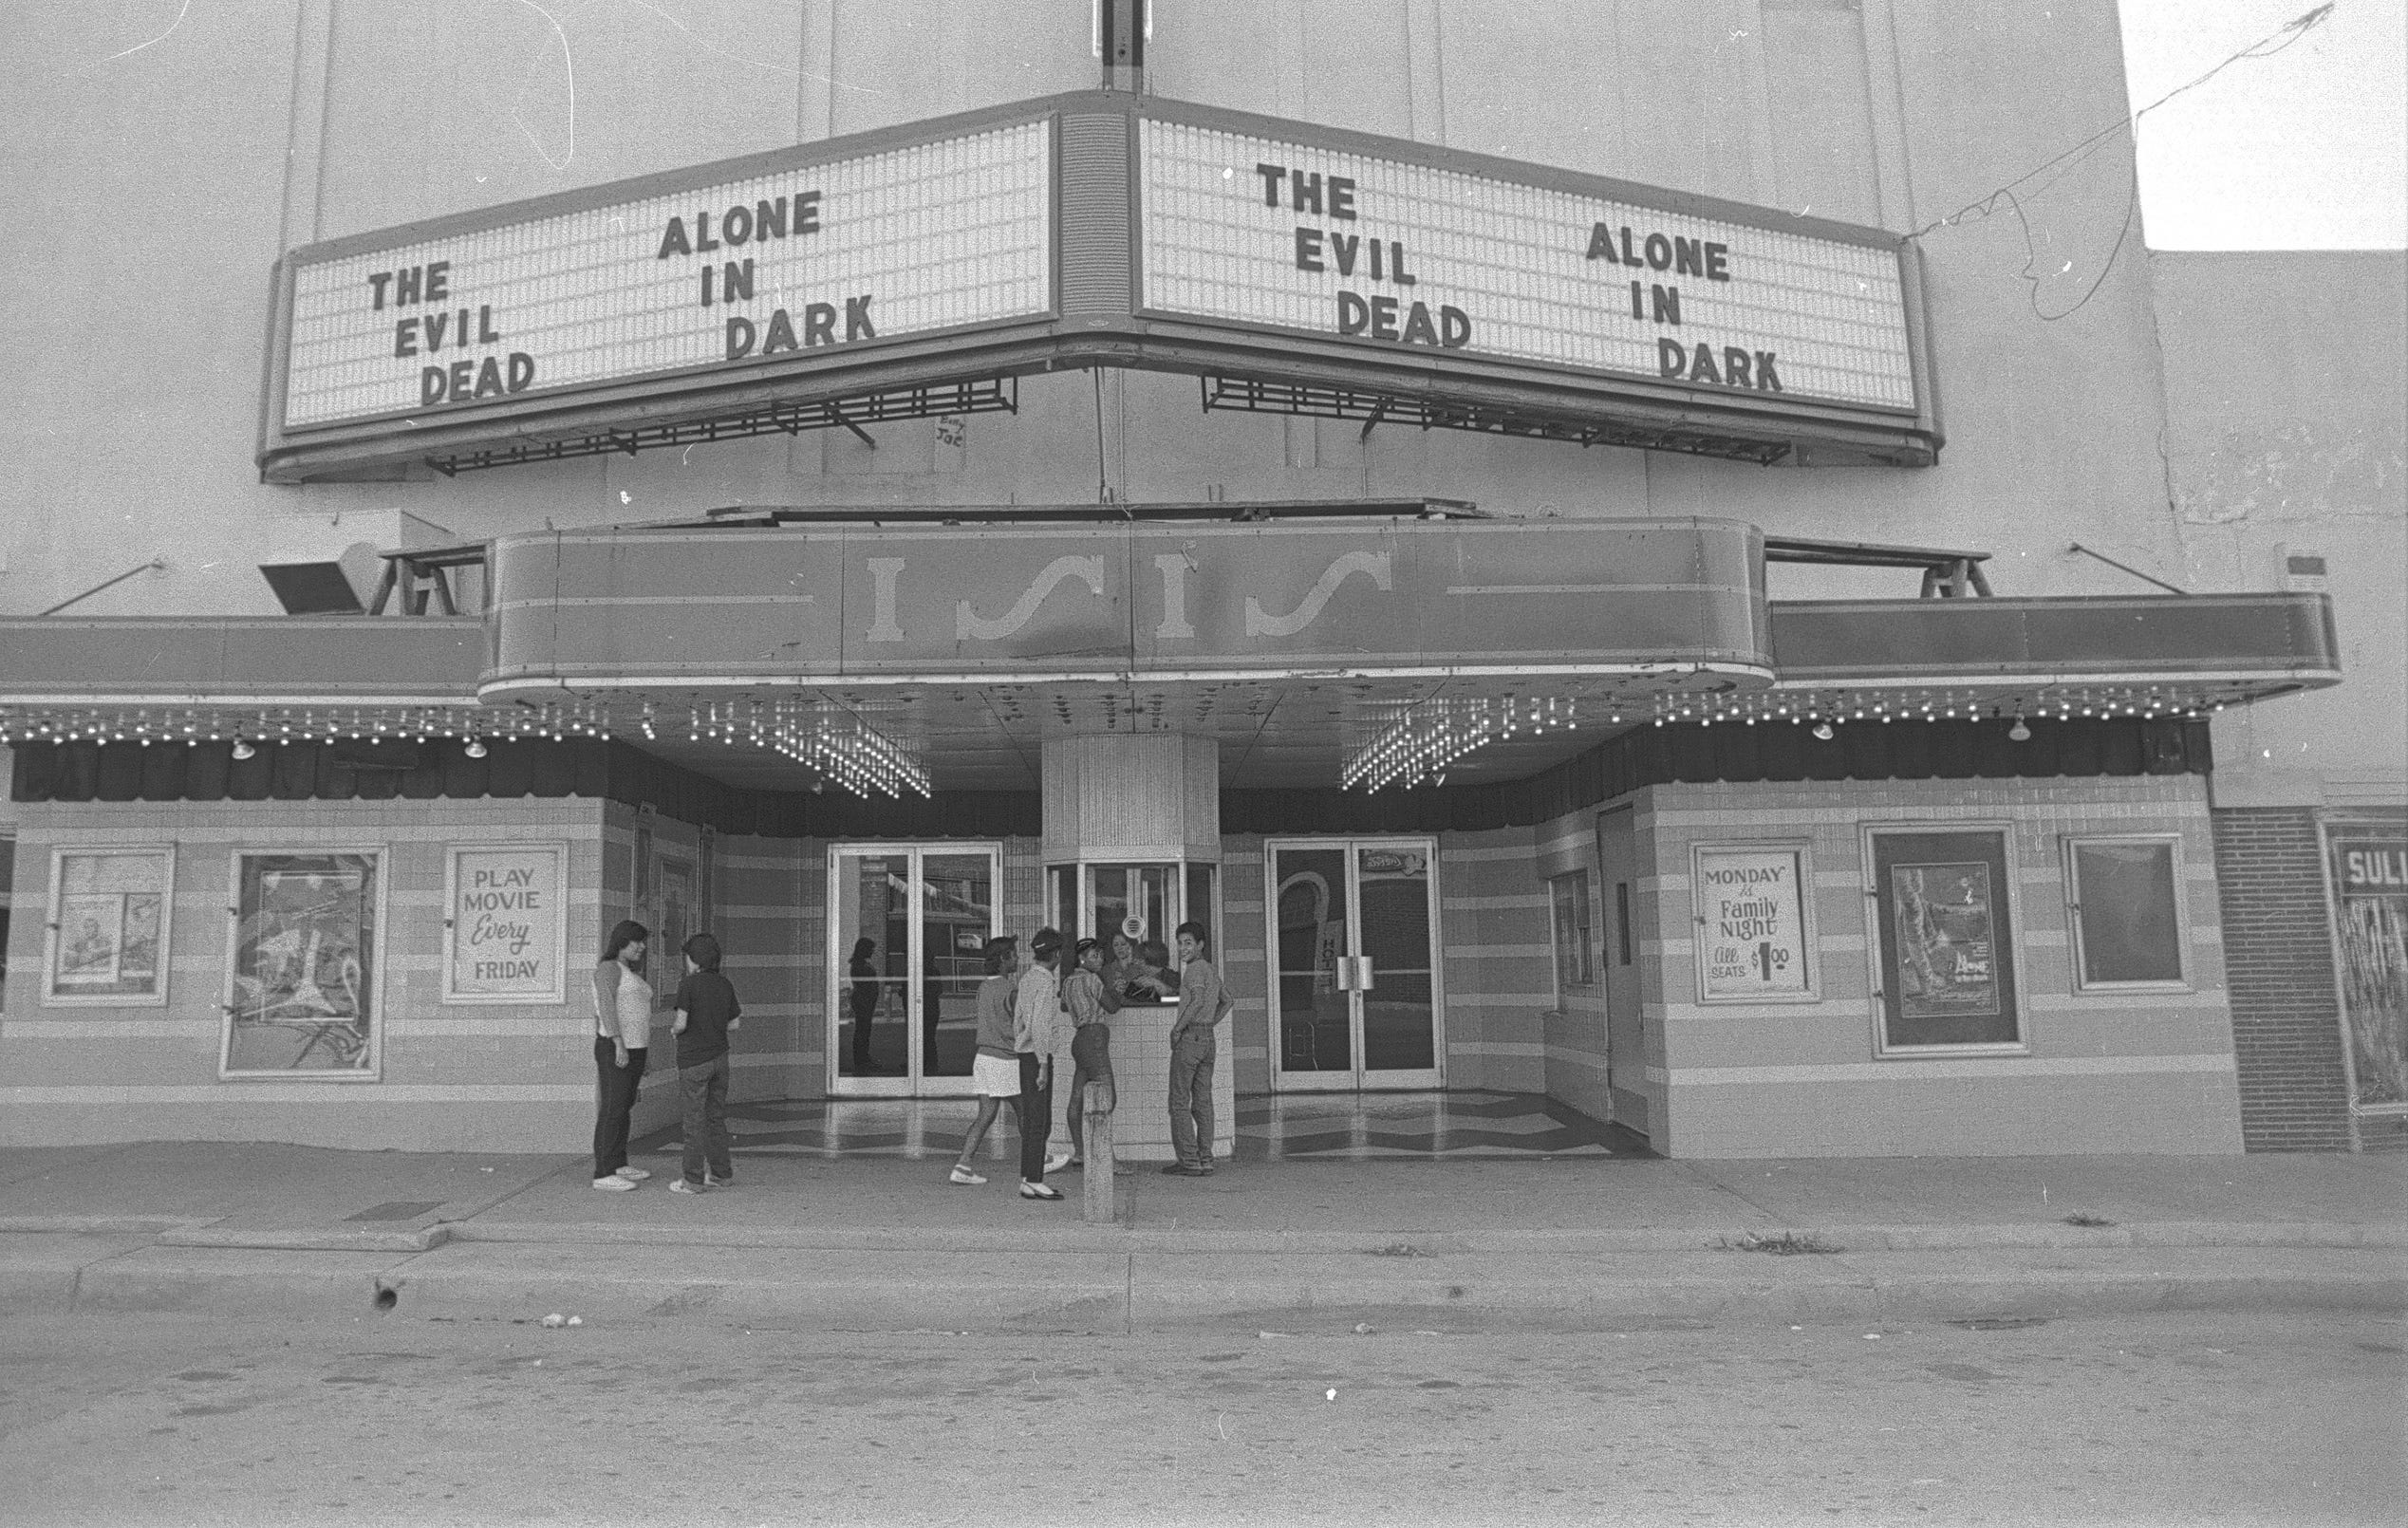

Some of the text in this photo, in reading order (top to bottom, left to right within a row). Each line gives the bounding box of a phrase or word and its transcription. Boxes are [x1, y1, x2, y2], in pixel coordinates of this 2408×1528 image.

[1256, 163, 1357, 220] THE
[658, 190, 822, 259] ALONE
[1296, 227, 1416, 286] EVIL
[1586, 222, 1730, 282] ALONE
[368, 261, 450, 310] THE
[700, 258, 755, 307] IN
[1632, 281, 1681, 326] IN
[394, 305, 499, 358] EVIL
[725, 294, 877, 361] DARK
[1336, 290, 1472, 348] DEAD
[420, 351, 535, 406] DEAD
[1657, 337, 1783, 392] DARK
[866, 551, 1391, 642] ISIS
[464, 891, 540, 911] MOVIE
[475, 868, 534, 887] PLAY
[1706, 866, 1785, 885] MONDAY
[1721, 897, 1779, 919] Family
[471, 913, 532, 956] Every
[476, 960, 539, 979] FRIDAY
[1710, 964, 1746, 978] SEATS
